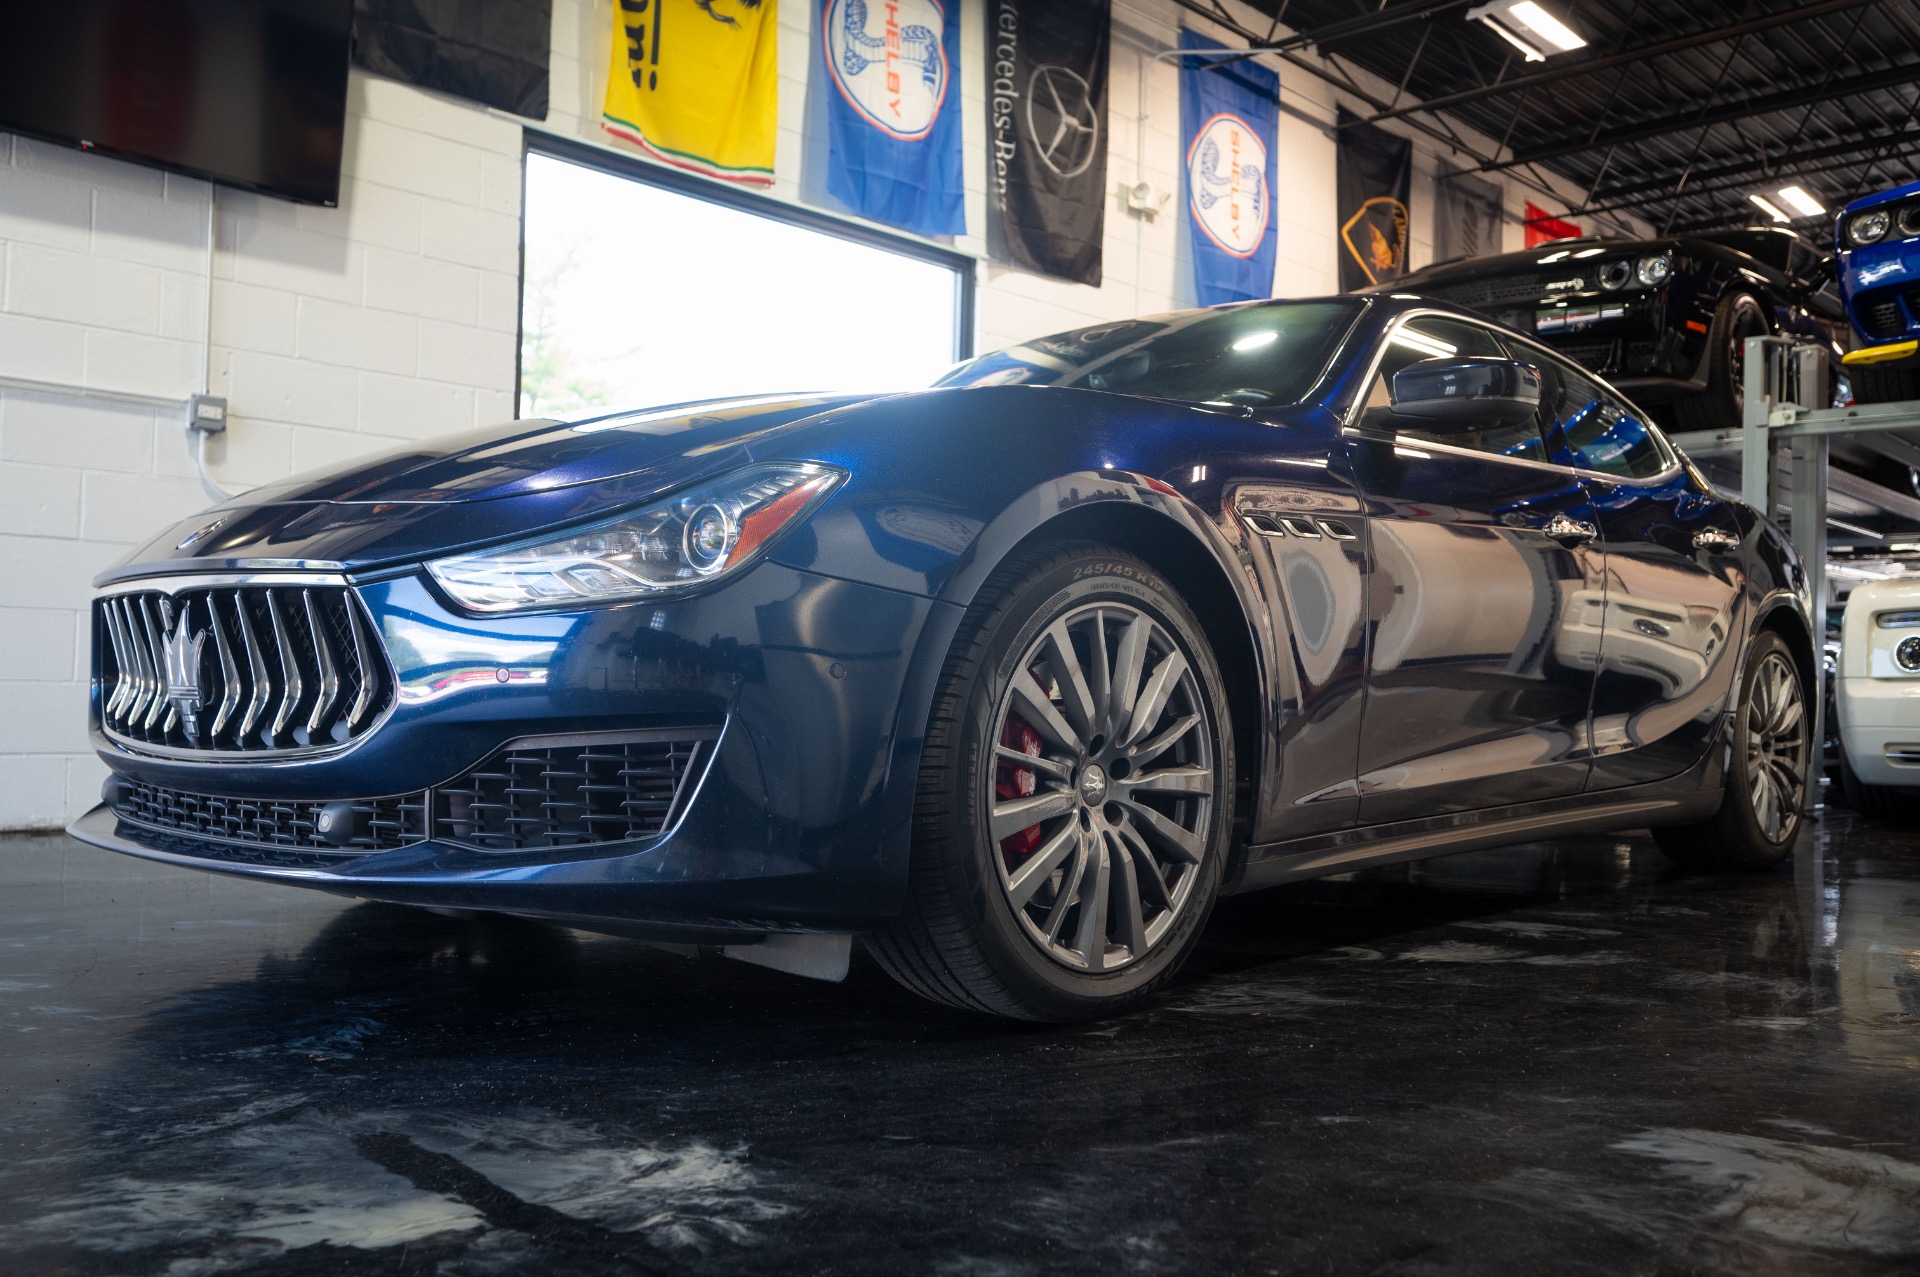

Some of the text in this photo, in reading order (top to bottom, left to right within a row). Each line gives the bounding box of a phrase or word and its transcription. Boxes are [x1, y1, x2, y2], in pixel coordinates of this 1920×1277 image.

[885, 0, 902, 118] HELBY
[1230, 129, 1240, 240] SHELBY
[1072, 563, 1133, 580] 245/45
